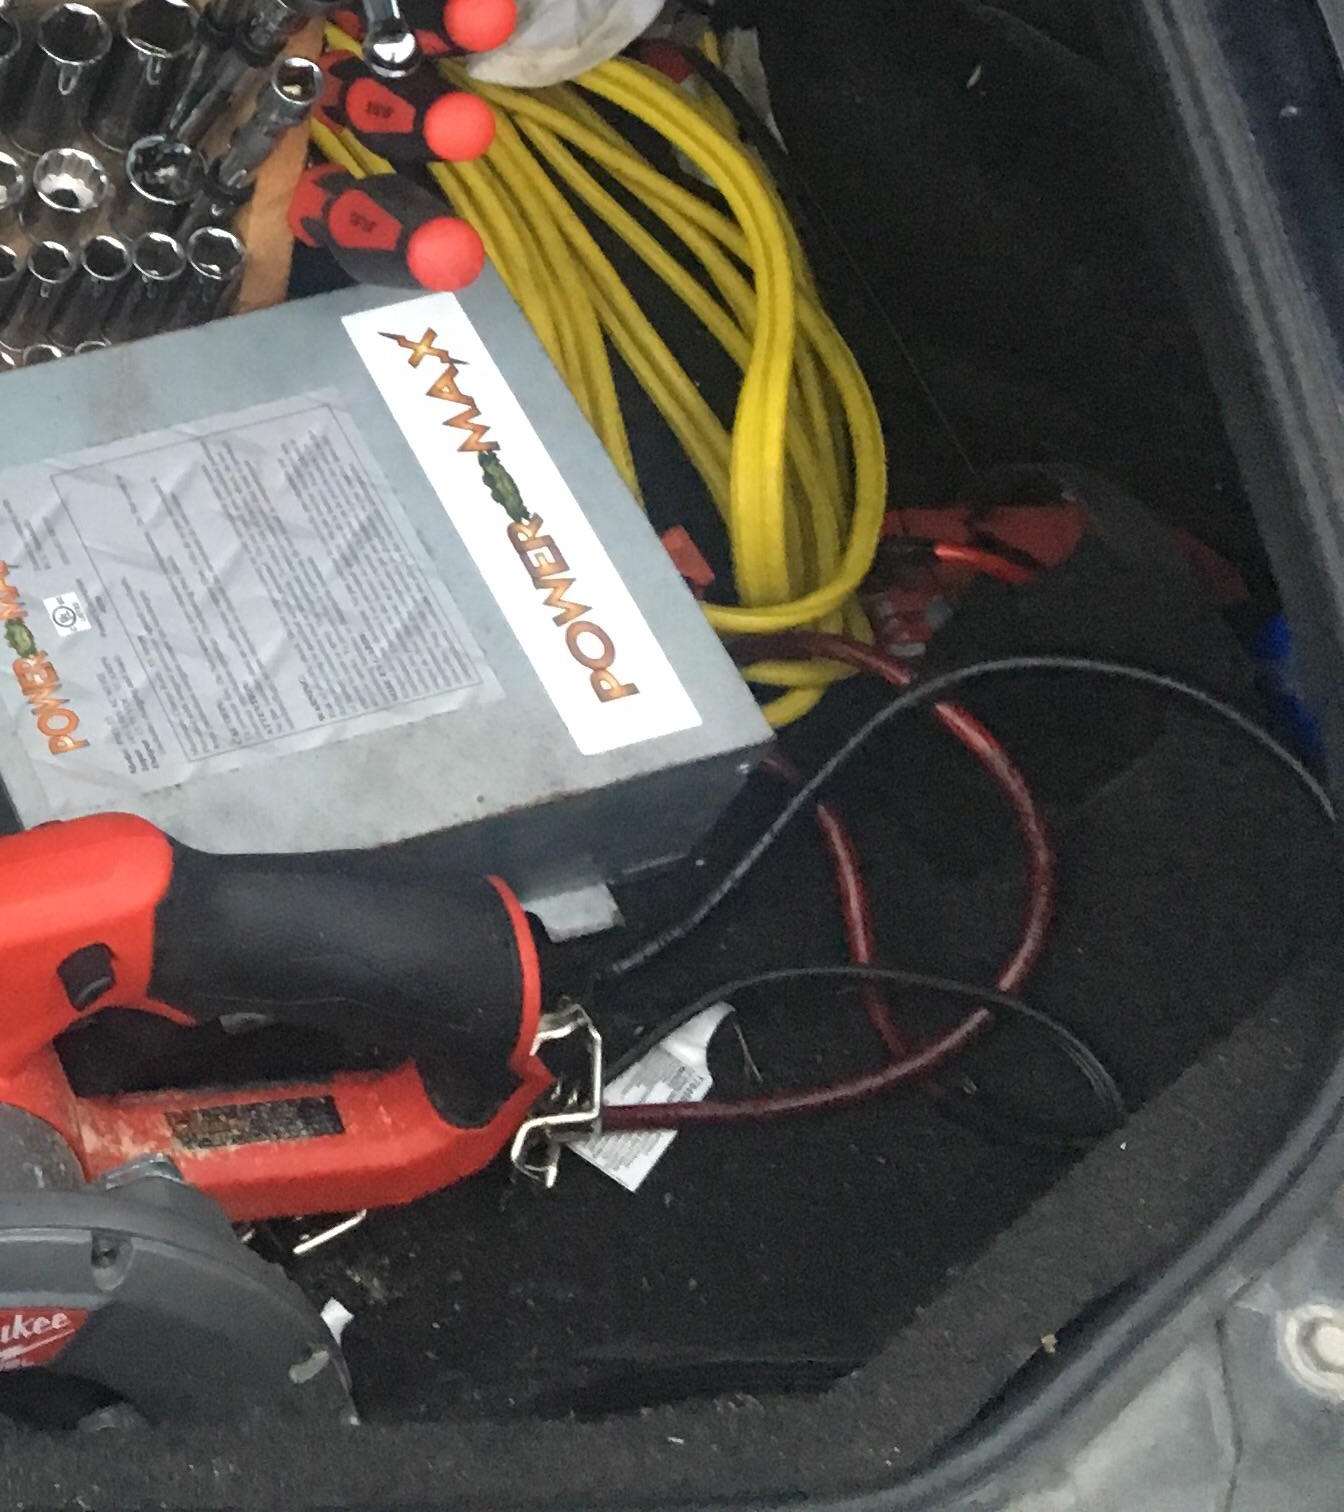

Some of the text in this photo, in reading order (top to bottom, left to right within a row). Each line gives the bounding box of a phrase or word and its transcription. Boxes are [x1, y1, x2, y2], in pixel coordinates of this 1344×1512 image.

[377, 327, 639, 703] POWER MAX
[12, 650, 90, 756] POWER
